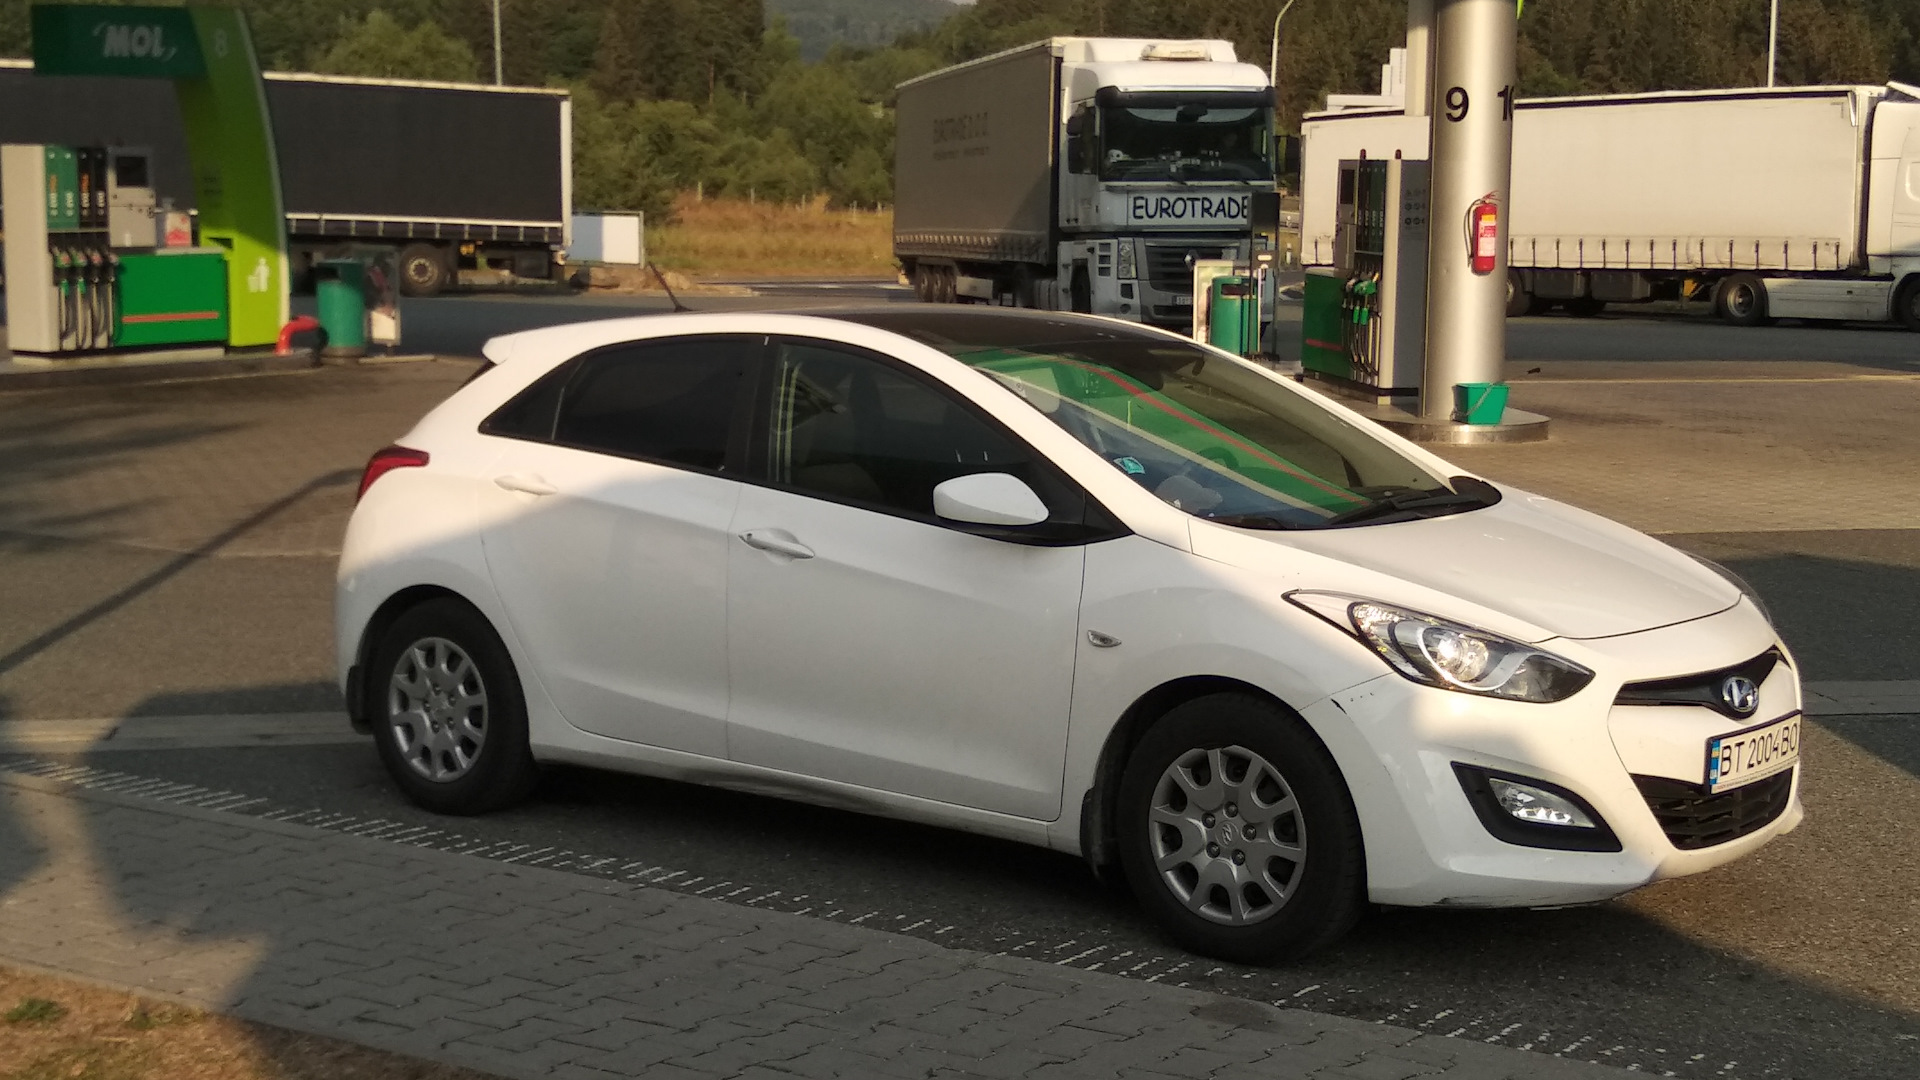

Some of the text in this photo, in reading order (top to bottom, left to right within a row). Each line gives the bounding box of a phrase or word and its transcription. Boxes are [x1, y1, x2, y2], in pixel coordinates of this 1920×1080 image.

[103, 25, 165, 58] MOL
[215, 28, 228, 58] 8
[1445, 85, 1514, 122] 9 1
[1132, 196, 1249, 220] EUROTRADE
[1720, 741, 1745, 776] BT
[1747, 728, 1779, 769] 2004
[1781, 722, 1798, 757] BO
